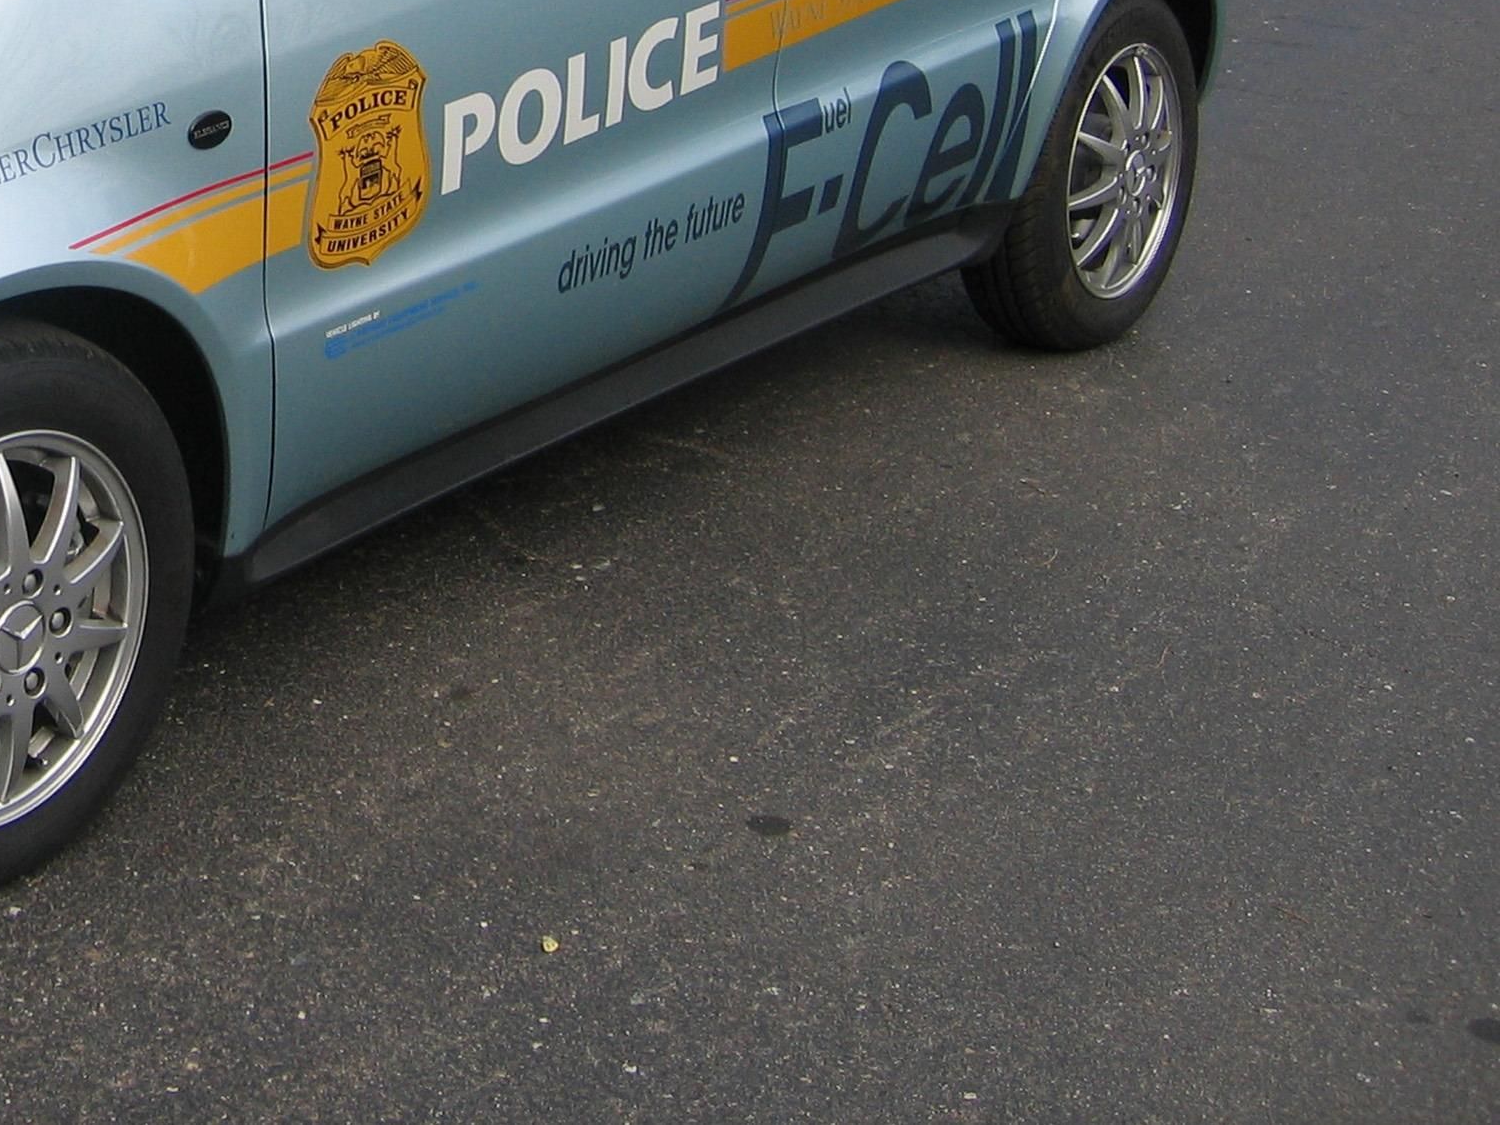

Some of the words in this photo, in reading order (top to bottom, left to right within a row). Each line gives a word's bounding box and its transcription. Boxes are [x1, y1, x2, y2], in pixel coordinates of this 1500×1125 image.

[329, 89, 407, 132] POLICE
[440, 0, 721, 196] POLICE
[327, 207, 410, 253] UNIVERSITY
[333, 213, 369, 231] WAYNE
[373, 191, 406, 221] STATE
[557, 234, 637, 294] driving
[643, 217, 678, 260] the
[684, 192, 745, 244] future
